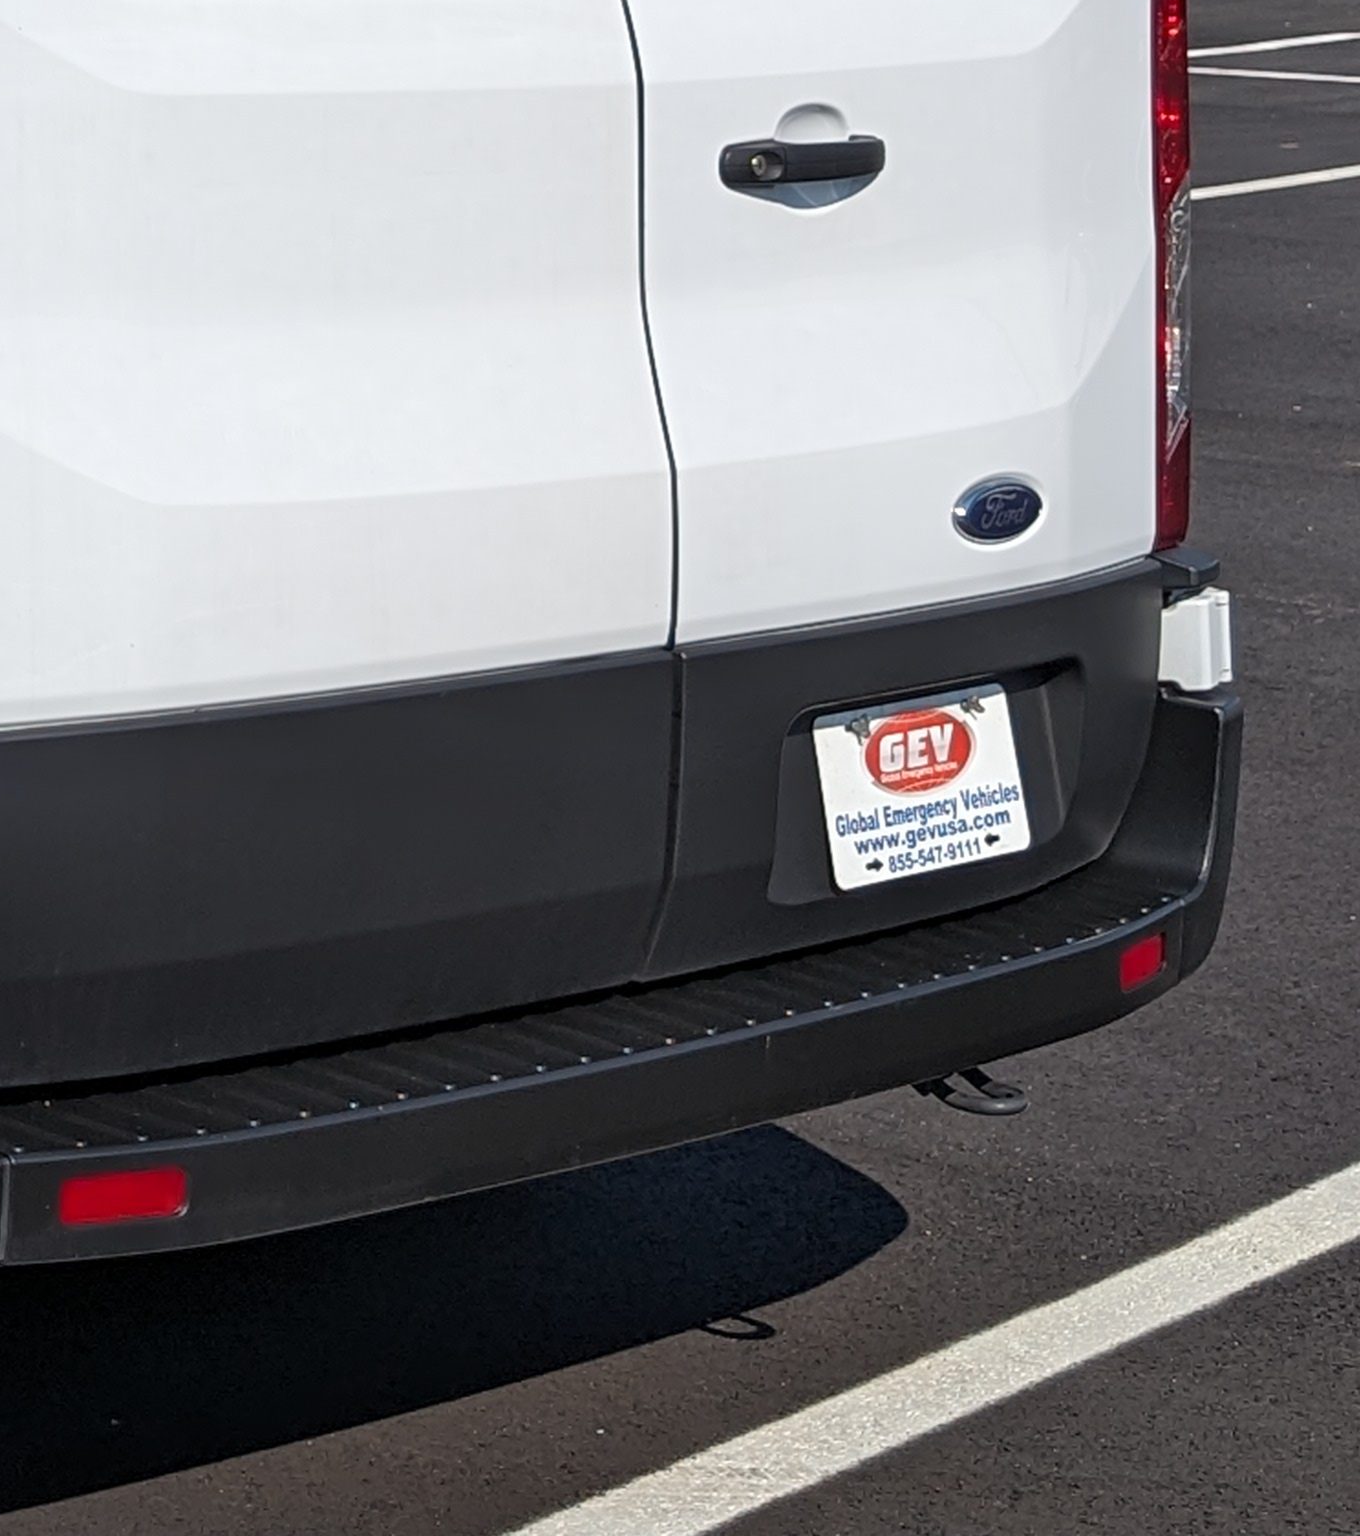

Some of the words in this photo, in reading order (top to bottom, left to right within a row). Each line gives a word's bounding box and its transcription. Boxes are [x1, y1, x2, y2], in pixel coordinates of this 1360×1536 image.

[981, 493, 1028, 529] Ford
[879, 723, 955, 774] GEV
[835, 808, 880, 837] Global
[883, 796, 958, 826] Emergency
[960, 783, 1020, 811] Vehicles
[854, 810, 1011, 854] www.gevusa.com
[889, 837, 981, 873] 855-547-9111
